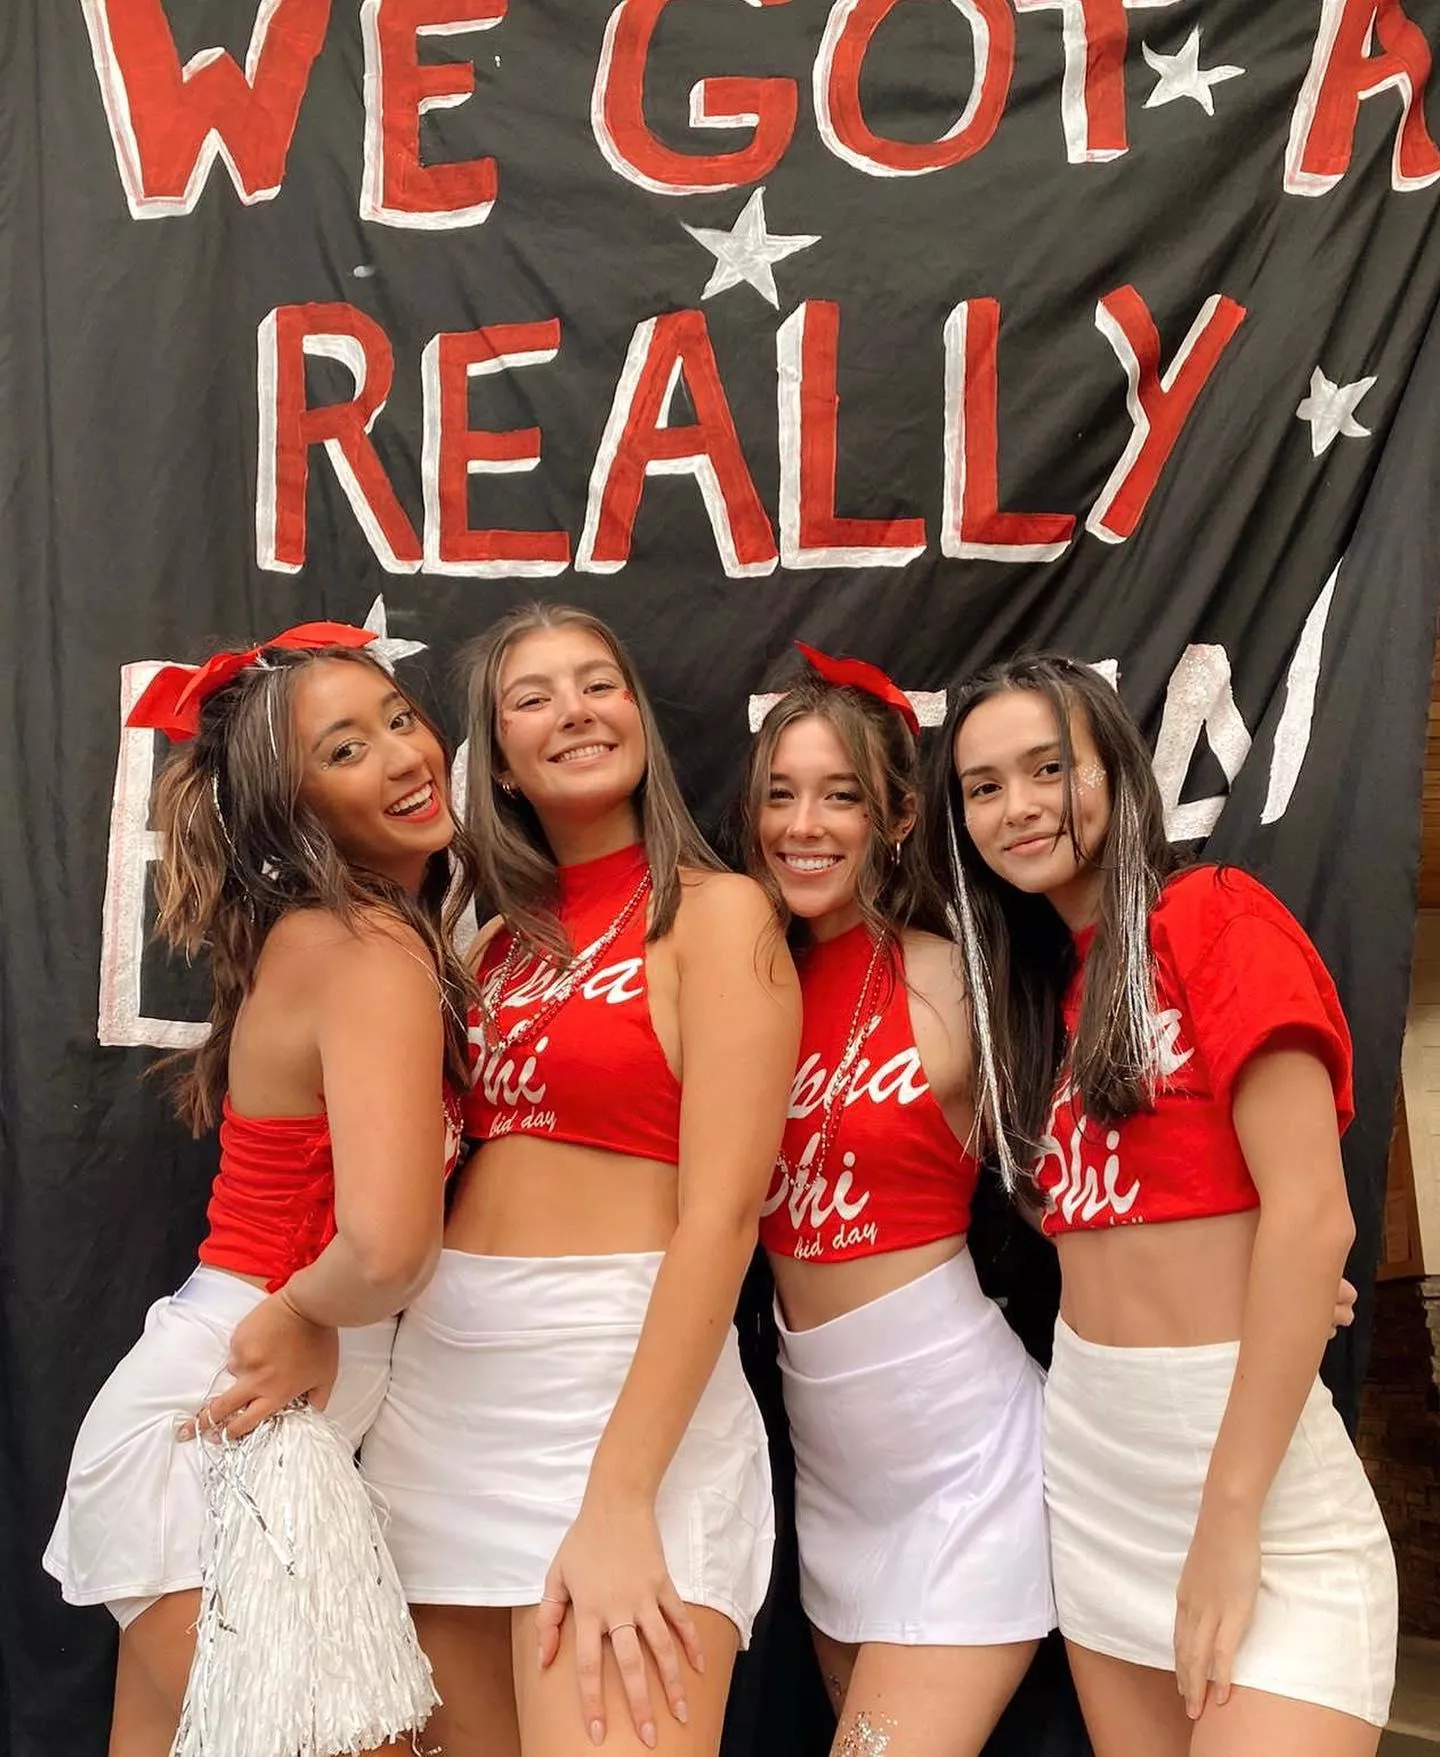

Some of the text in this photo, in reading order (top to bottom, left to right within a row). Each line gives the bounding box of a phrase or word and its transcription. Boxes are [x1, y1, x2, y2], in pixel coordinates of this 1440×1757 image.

[82, 0, 1440, 230] WE GOT A
[256, 283, 1247, 578] REALLY
[489, 1106, 557, 1138] bid day
[793, 1220, 879, 1260] bid day
